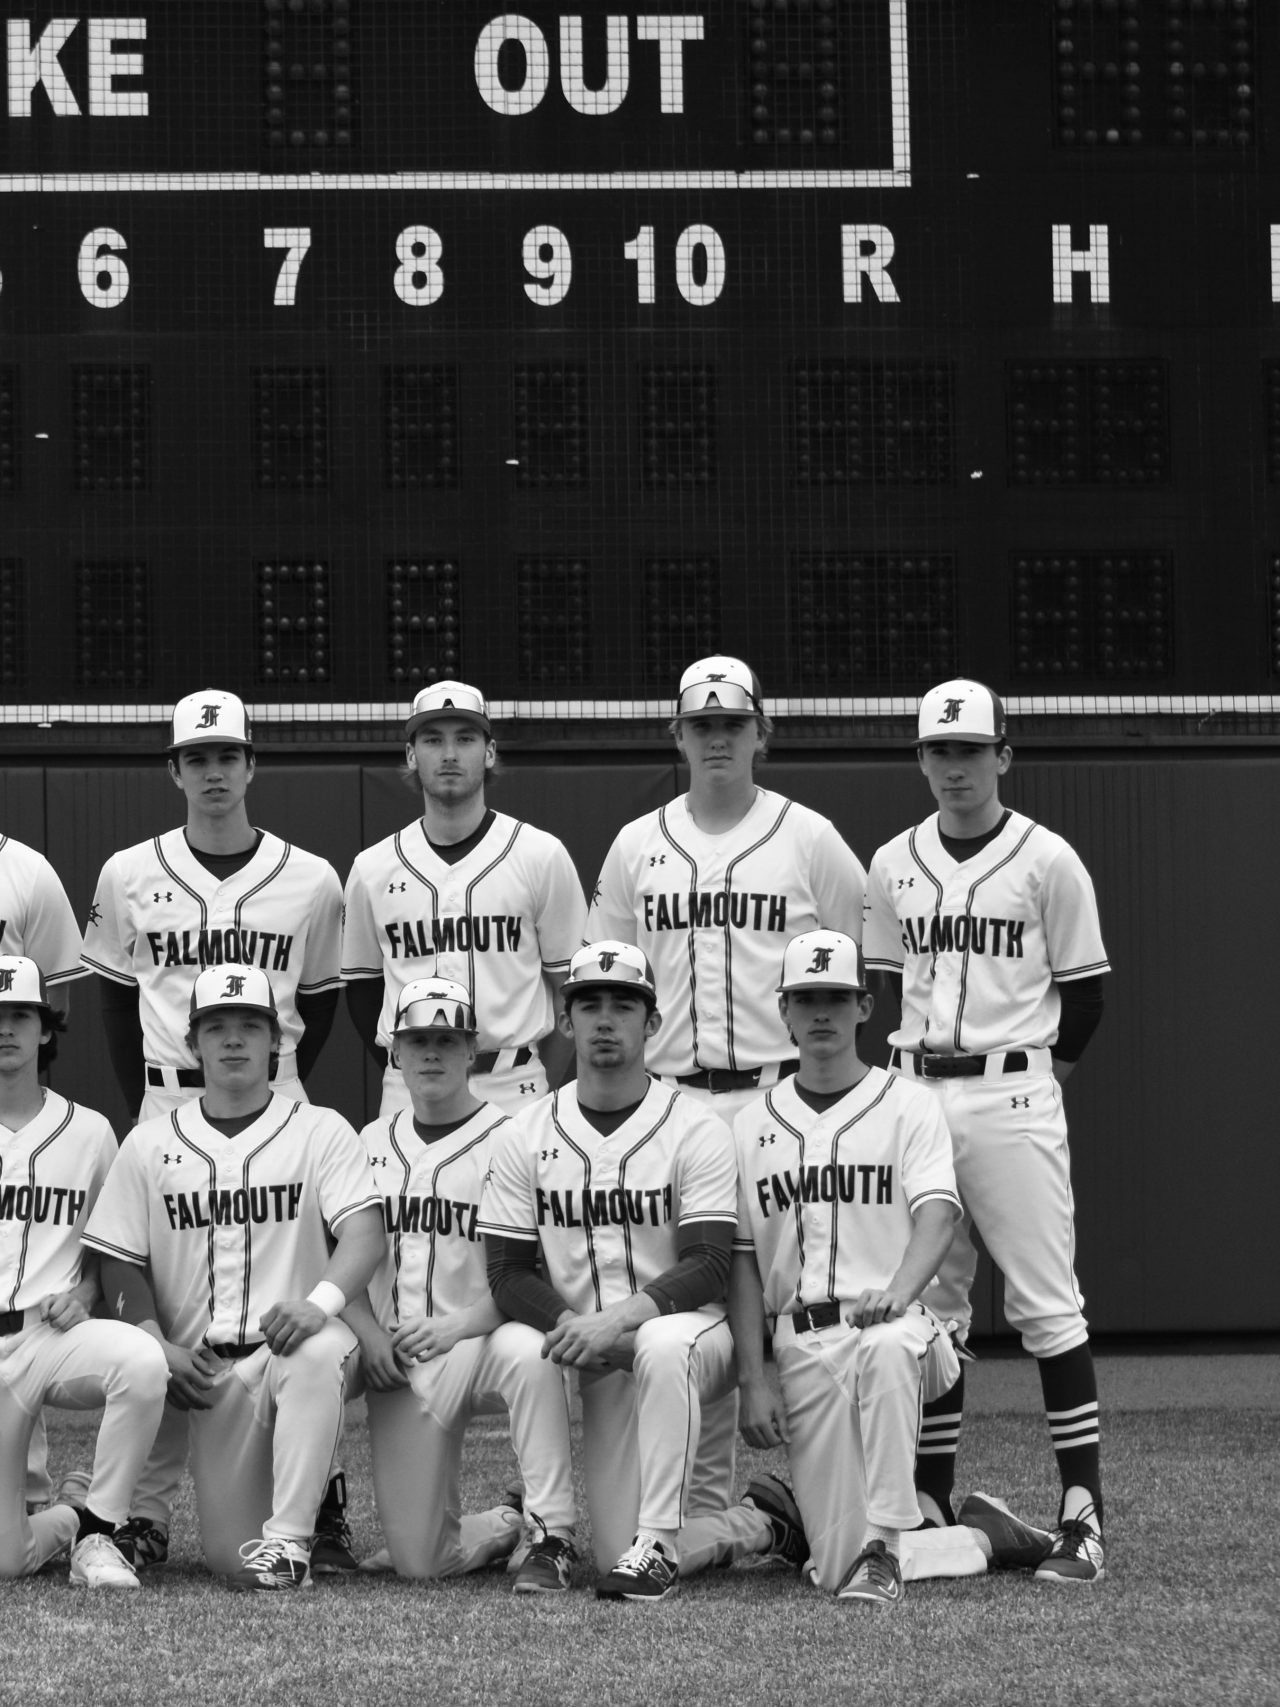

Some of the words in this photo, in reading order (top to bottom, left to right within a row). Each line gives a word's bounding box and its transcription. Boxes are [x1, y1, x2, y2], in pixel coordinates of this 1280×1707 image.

[476, 16, 705, 116] OUT
[79, 229, 130, 309] 6
[265, 229, 312, 306] 7
[395, 227, 444, 307] 8
[524, 226, 572, 307] 9
[626, 225, 726, 306] 10
[843, 226, 901, 303] R
[1053, 226, 1110, 303] H
[643, 892, 787, 932] FALMOUTH
[147, 928, 293, 971] FALMOUTH
[385, 916, 521, 958] FALMOUTH
[164, 1182, 303, 1230] FALMOUTH
[536, 1183, 672, 1228] FALMOUTH
[756, 1164, 893, 1218] FALMOUTH
[385, 1195, 481, 1242] LMOUTH
